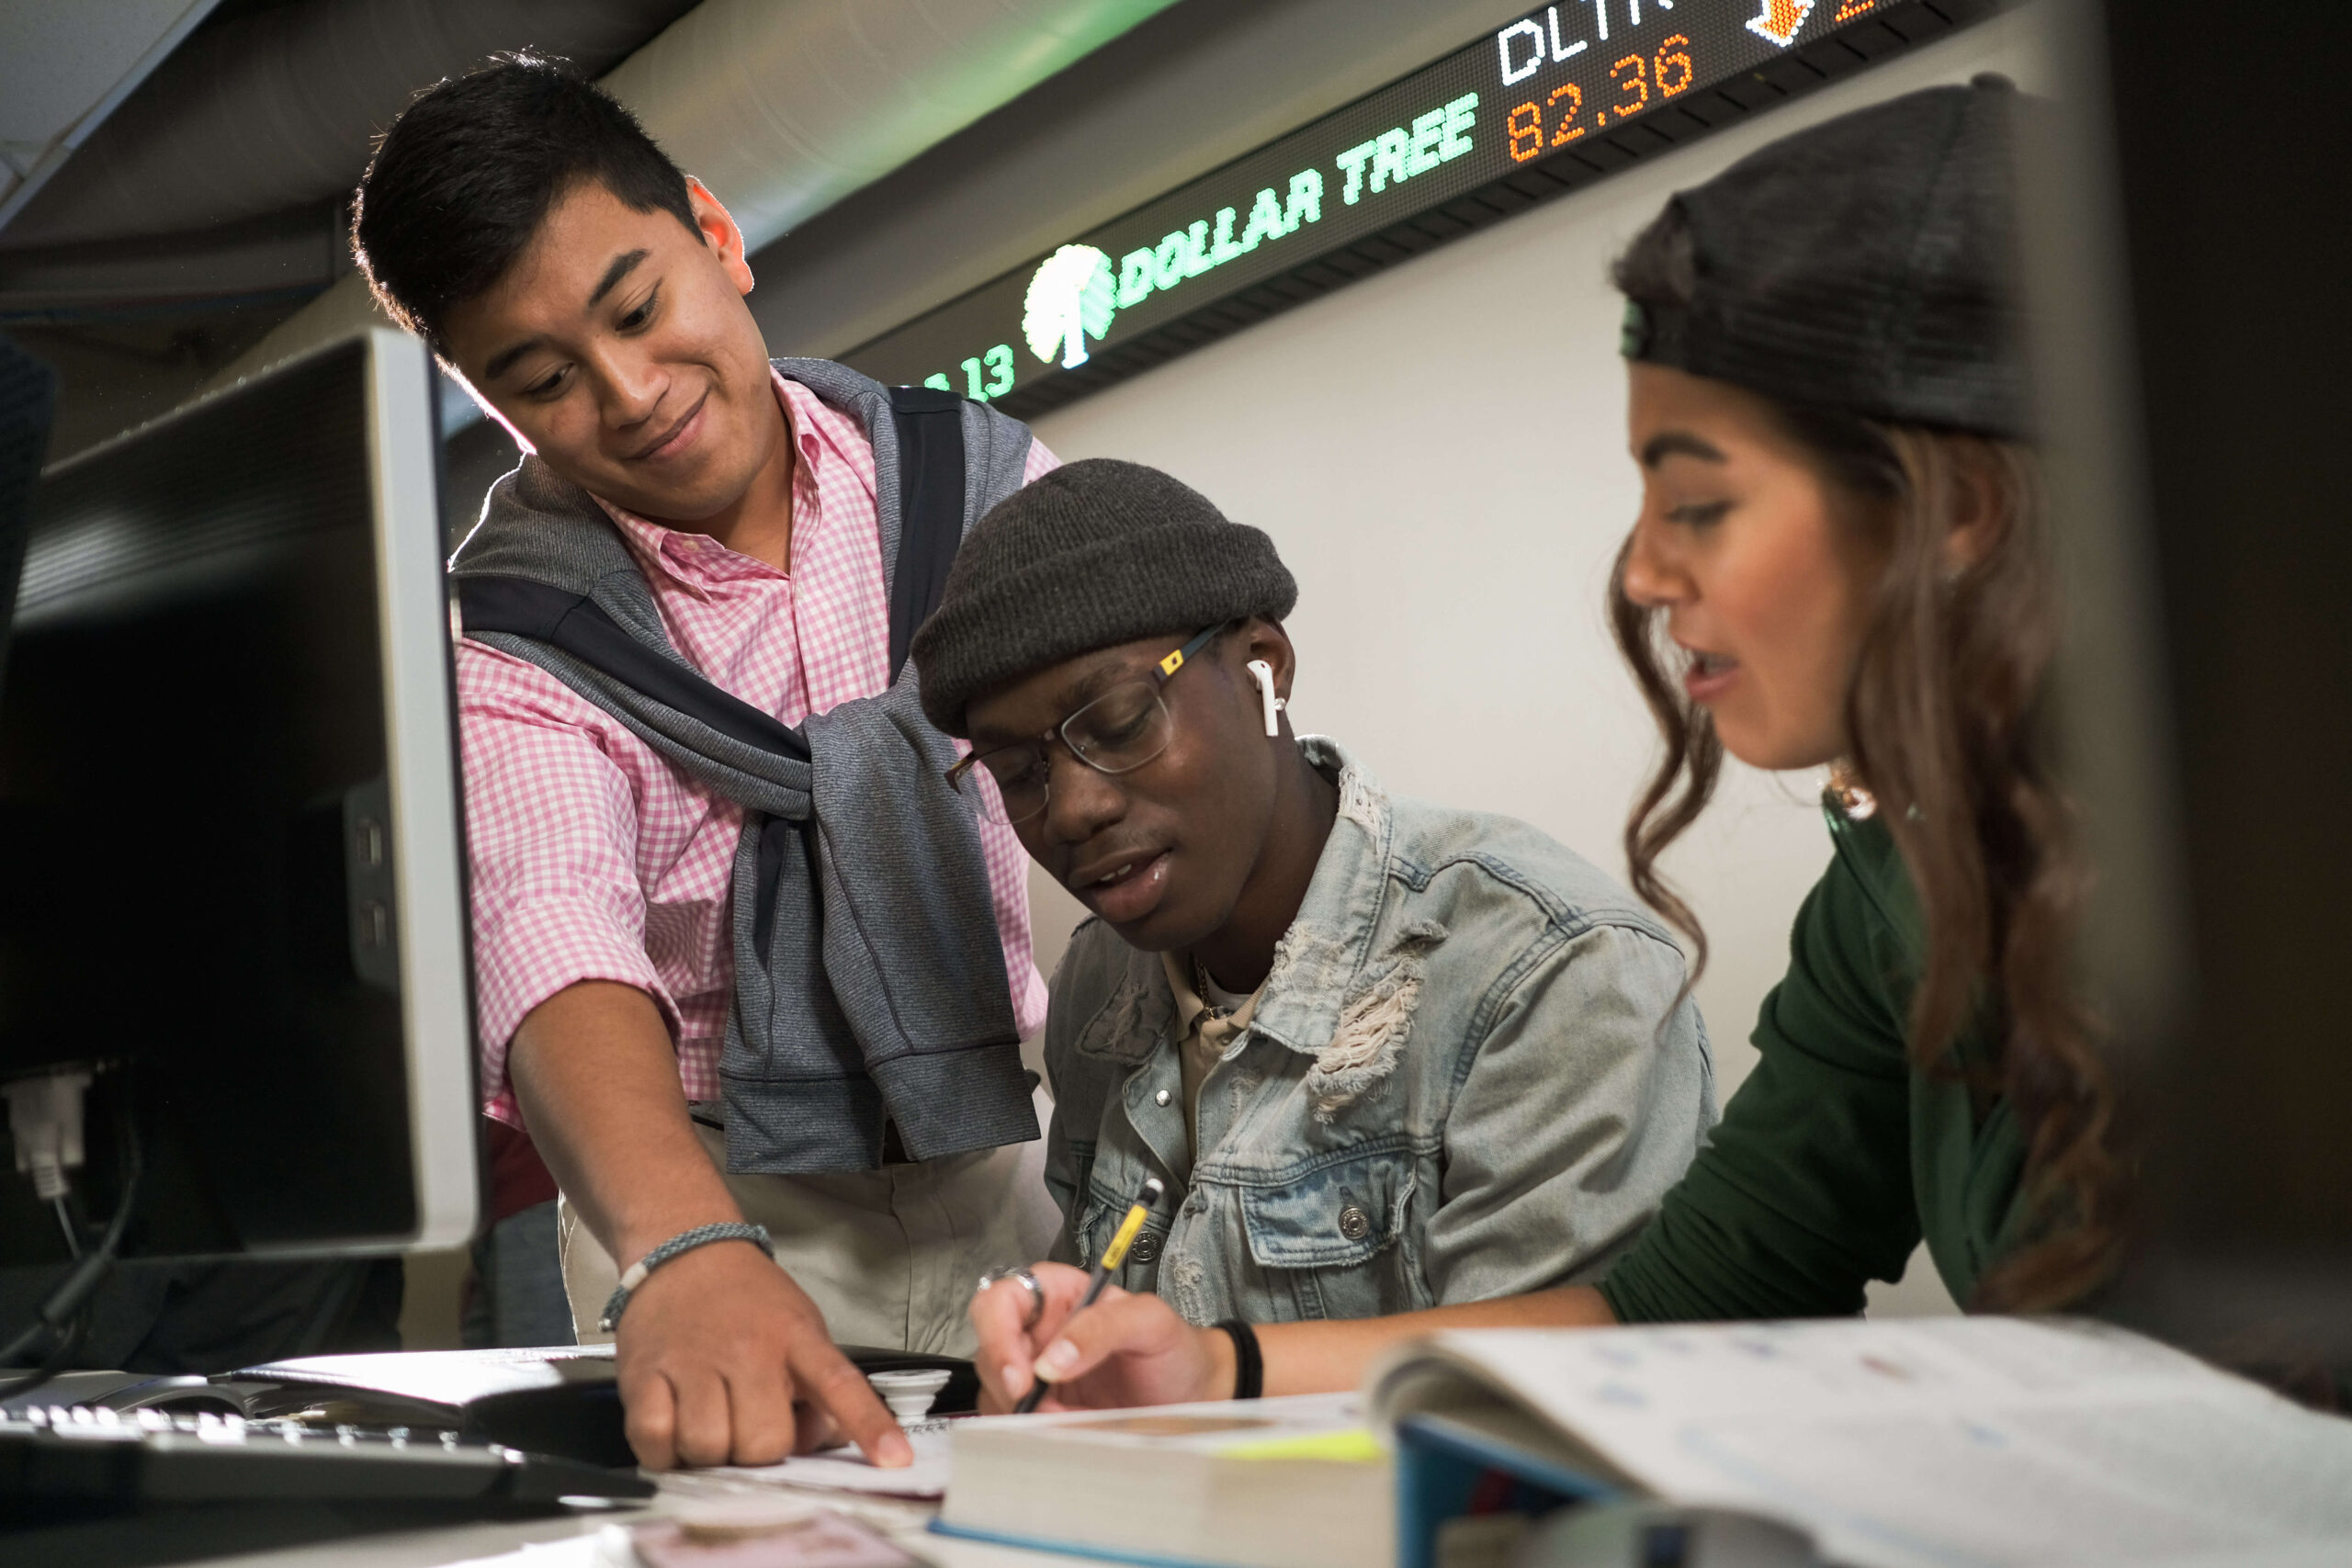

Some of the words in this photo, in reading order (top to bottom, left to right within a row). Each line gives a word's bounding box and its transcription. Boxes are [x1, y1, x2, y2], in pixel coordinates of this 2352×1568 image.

[1507, 33, 1693, 163] 82.36
[1116, 168, 1323, 310] DOLLAR
[1336, 92, 1479, 206] TREE
